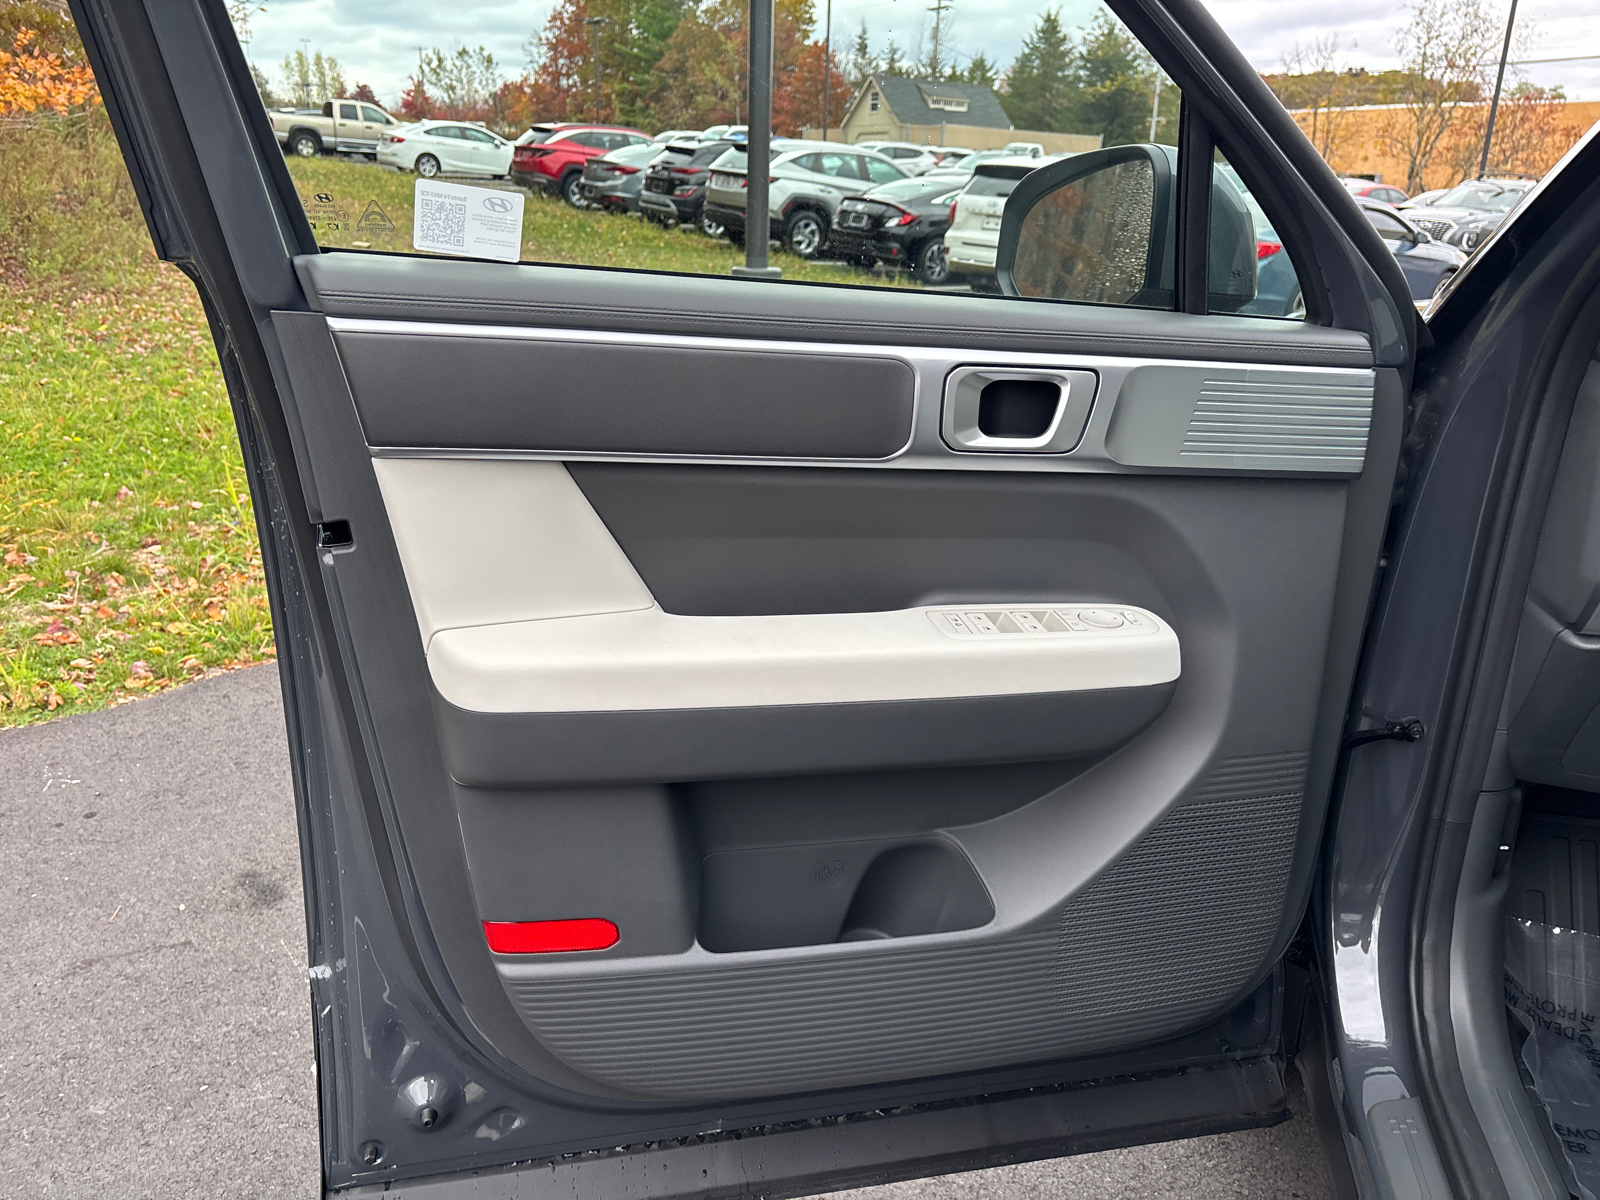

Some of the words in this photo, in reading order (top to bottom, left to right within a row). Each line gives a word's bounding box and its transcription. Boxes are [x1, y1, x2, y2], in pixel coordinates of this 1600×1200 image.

[1525, 1004, 1576, 1040] DEALER
[1554, 1122, 1600, 1140] EMO
[1562, 1138, 1592, 1155] ER
